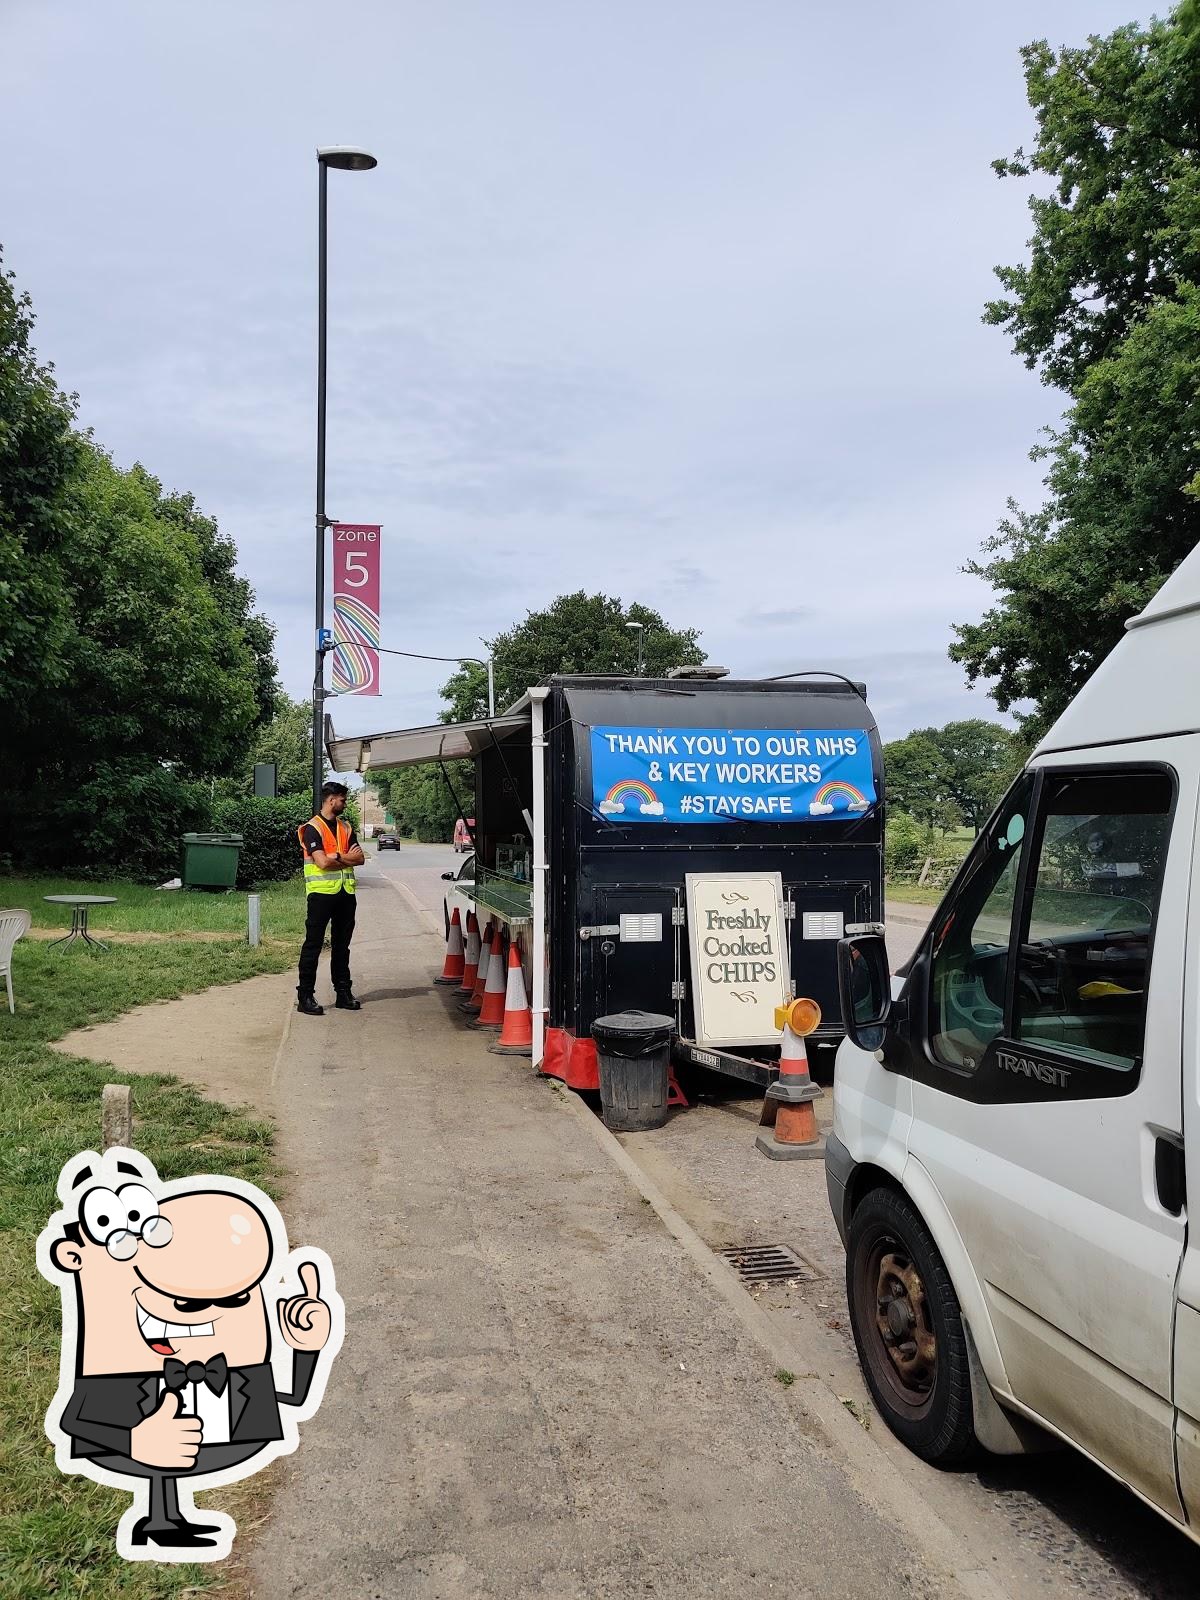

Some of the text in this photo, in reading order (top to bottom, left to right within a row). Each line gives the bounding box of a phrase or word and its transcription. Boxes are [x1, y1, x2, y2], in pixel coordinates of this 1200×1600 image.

[336, 530, 377, 542] zone
[344, 551, 369, 587] 5
[605, 734, 857, 756] THANK YOU TO OUR NHS
[648, 762, 822, 783] & KEY WORKERS
[680, 795, 793, 815] #STAYSAFE
[705, 908, 771, 933] Freshly
[704, 935, 774, 957] Cooked
[707, 961, 776, 984] CHIPS
[995, 1051, 1072, 1088] TRANSIT
